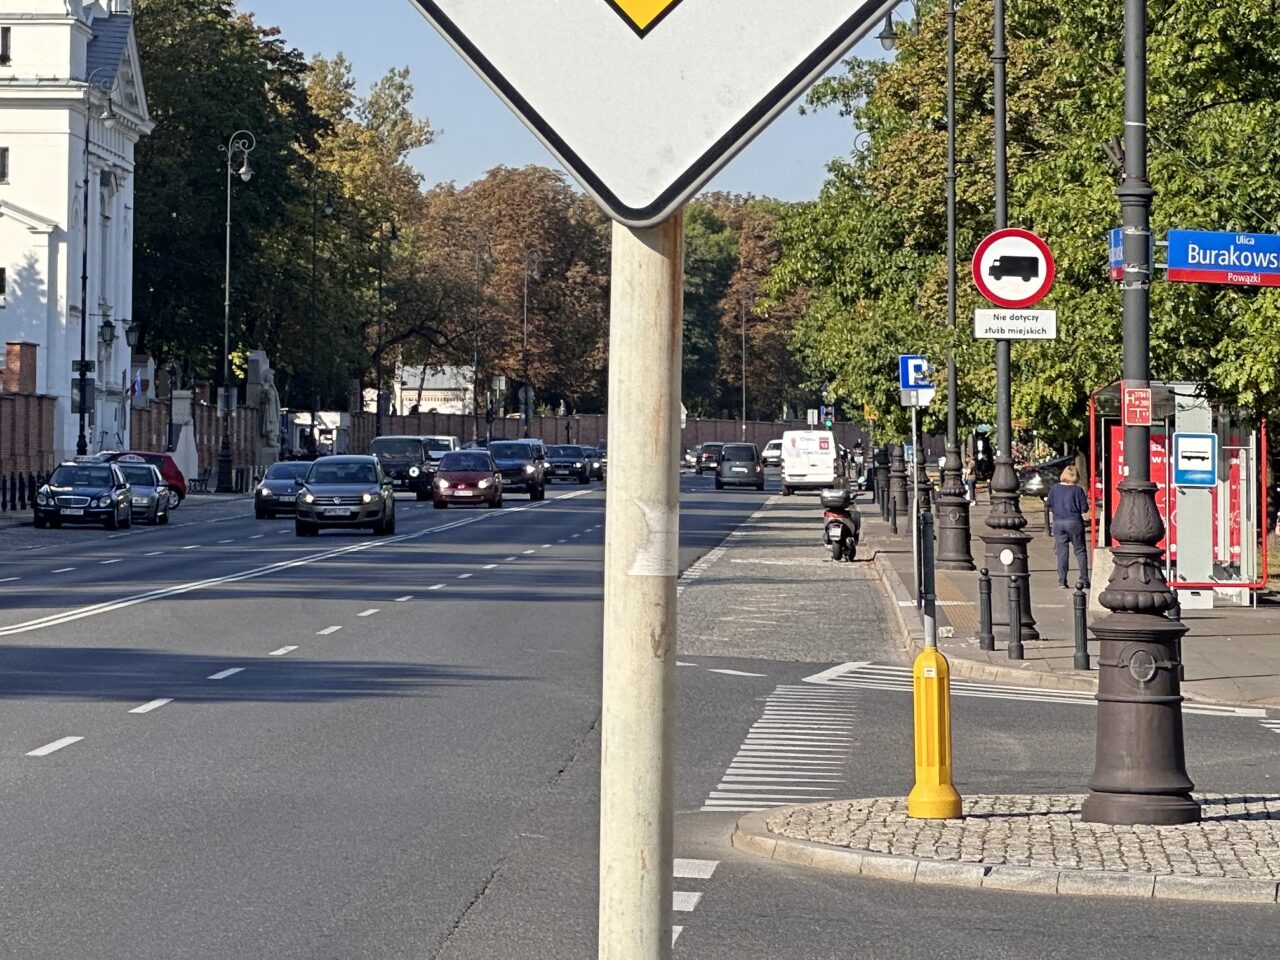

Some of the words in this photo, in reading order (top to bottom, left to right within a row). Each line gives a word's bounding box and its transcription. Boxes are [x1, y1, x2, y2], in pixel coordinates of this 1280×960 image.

[1236, 235, 1255, 245] Ulica
[1228, 272, 1261, 283] Powązki
[1009, 313, 1040, 323] dotyczy
[1008, 327, 1047, 336] miejskich
[1126, 393, 1134, 404] H
